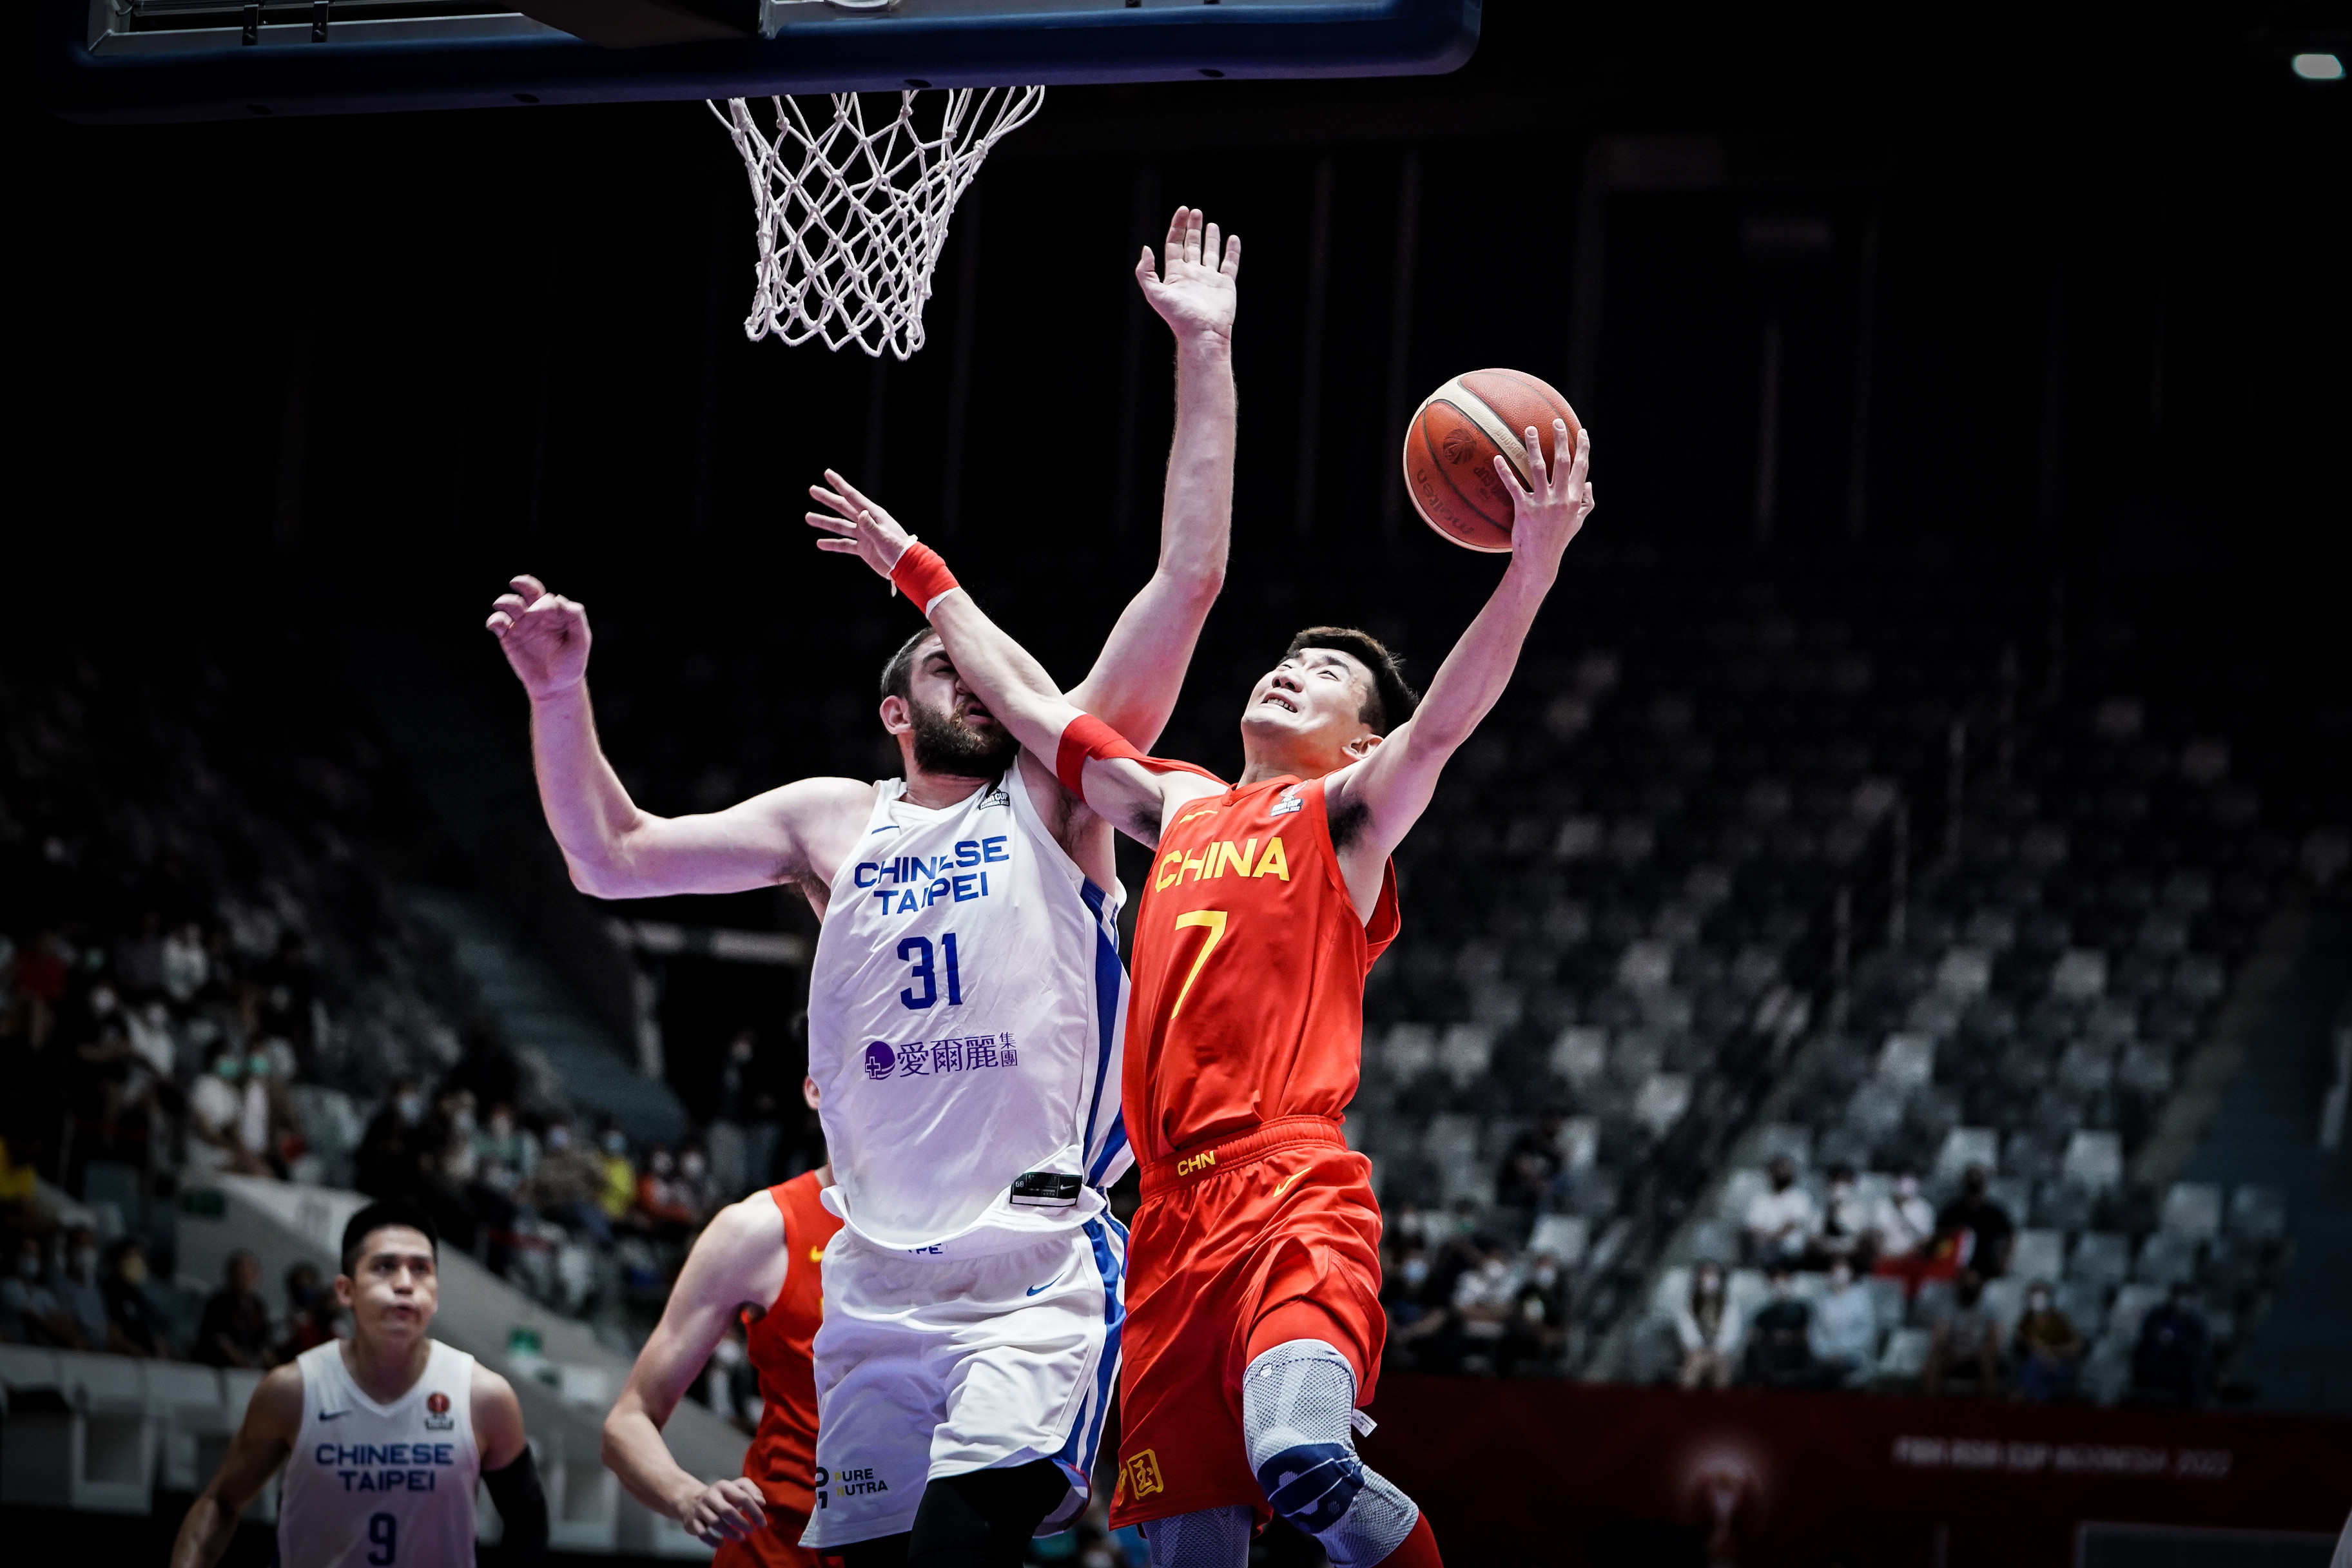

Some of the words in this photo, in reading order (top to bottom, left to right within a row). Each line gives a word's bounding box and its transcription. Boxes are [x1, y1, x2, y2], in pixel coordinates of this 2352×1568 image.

[1416, 468, 1474, 536] molten
[1155, 837, 1290, 893] CHINA
[873, 871, 989, 916] TAIPEI
[897, 933, 963, 1010] 31
[1171, 910, 1228, 1020] 7
[1177, 1150, 1216, 1176] CHN
[315, 1444, 454, 1465] CHINESE
[834, 1467, 874, 1483] PURE
[338, 1470, 435, 1491] TAIPEI
[836, 1480, 889, 1497] NUTRA
[367, 1512, 398, 1566] 9
